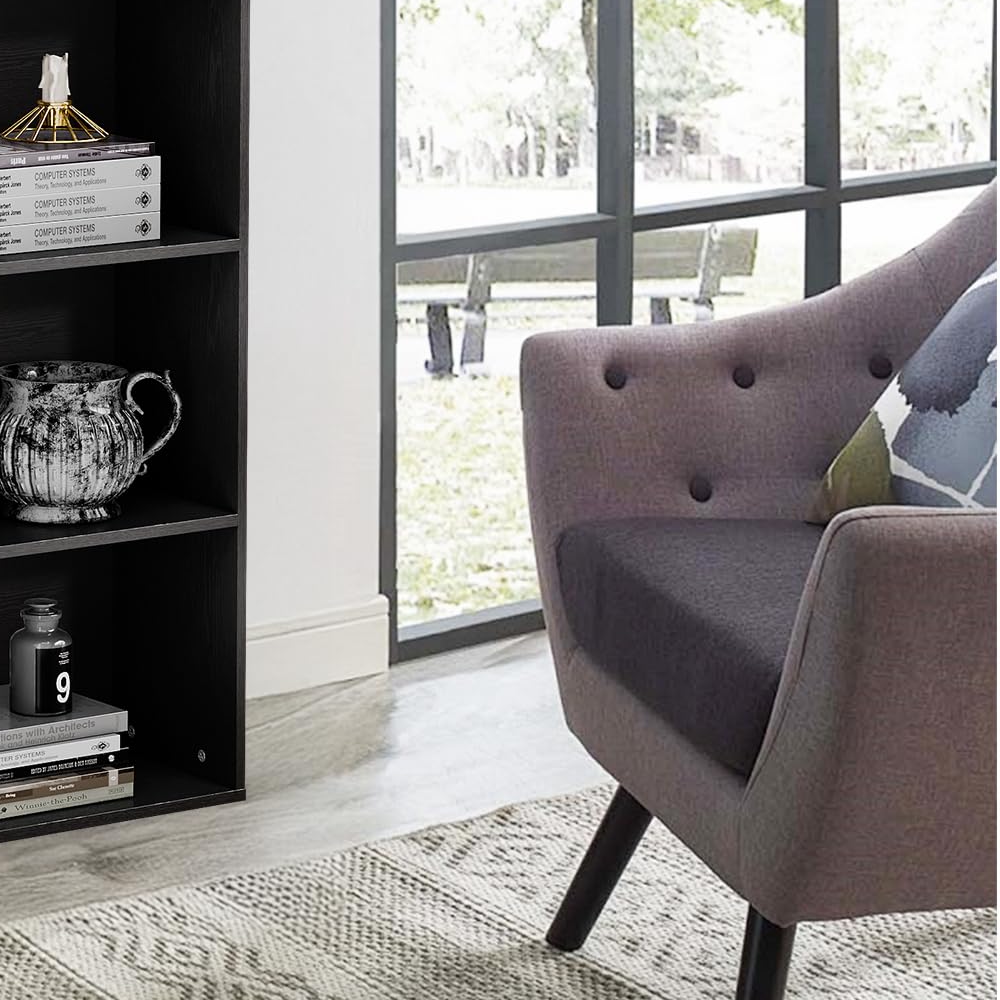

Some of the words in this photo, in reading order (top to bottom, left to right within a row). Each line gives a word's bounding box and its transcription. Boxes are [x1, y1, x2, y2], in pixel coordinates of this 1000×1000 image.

[10, 157, 27, 165] Paris
[34, 169, 67, 181] COMPUTER
[68, 168, 96, 178] SYSTEMS
[34, 182, 49, 190] Theory,
[50, 181, 72, 189] Technology,
[82, 178, 107, 186] Applications
[34, 197, 67, 209] COMPUTER
[68, 196, 96, 206] SYSTEMS
[34, 210, 49, 218] Theory,
[50, 209, 72, 217] Technology,
[82, 206, 107, 214] Applications
[34, 226, 67, 238] COMPUTER
[68, 224, 96, 235] SYSTEMS
[50, 238, 72, 246] Technology,
[82, 234, 107, 242] Applications
[56, 671, 70, 703] 9
[25, 728, 45, 739] with
[46, 719, 96, 736] Architects
[7, 740, 23, 749] and
[25, 736, 54, 746] Heinrich
[14, 750, 46, 762] SYSTEMS
